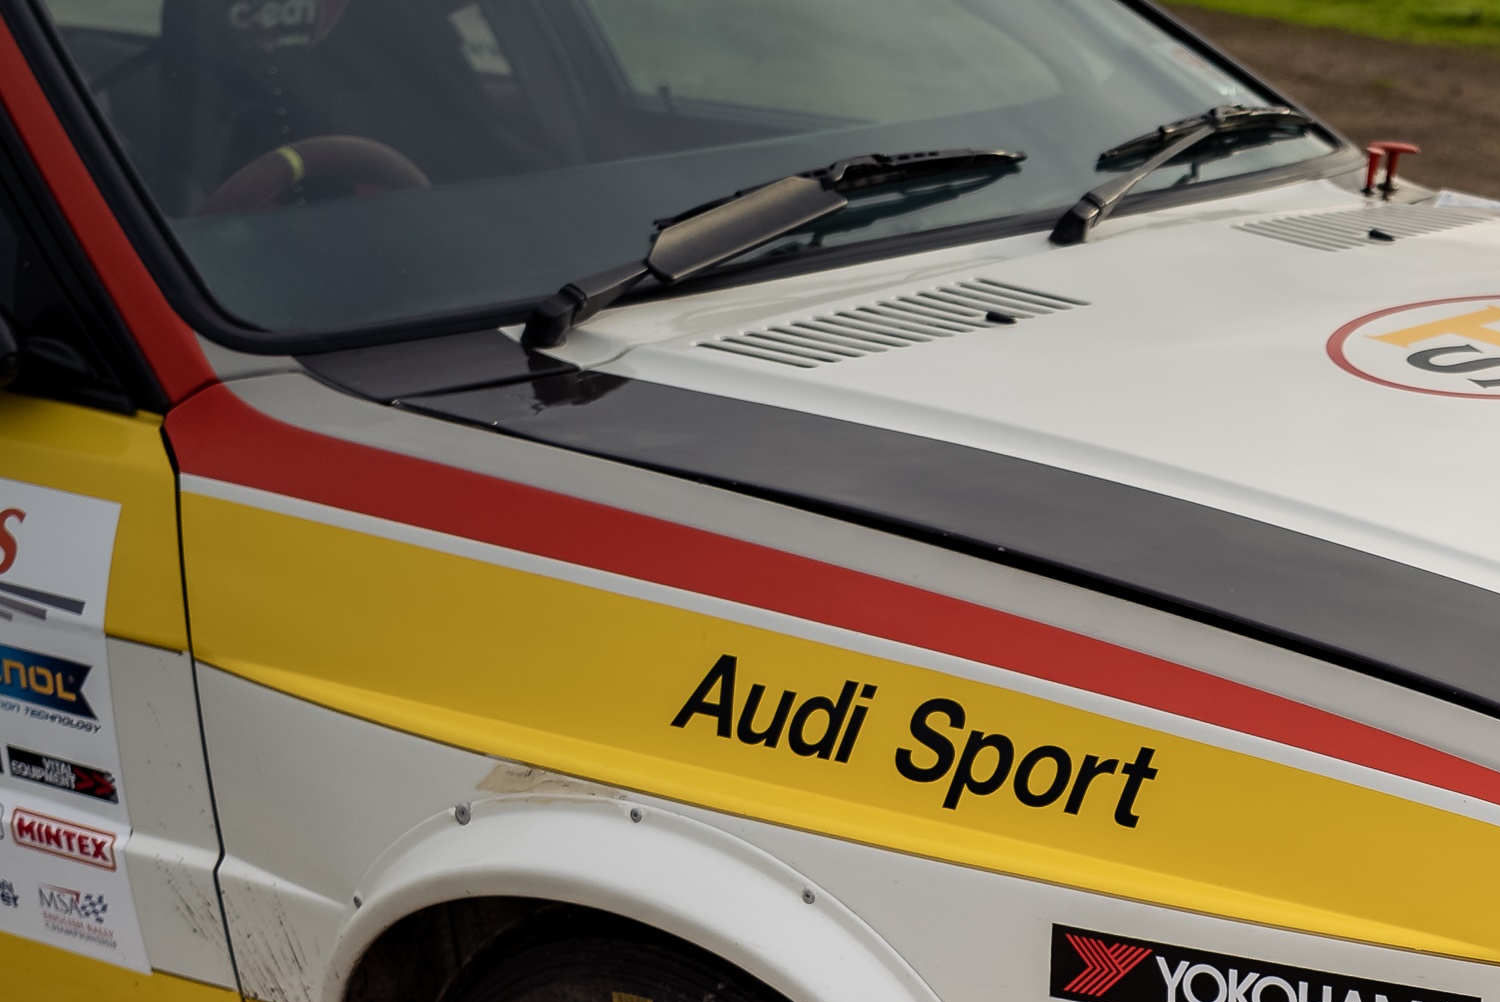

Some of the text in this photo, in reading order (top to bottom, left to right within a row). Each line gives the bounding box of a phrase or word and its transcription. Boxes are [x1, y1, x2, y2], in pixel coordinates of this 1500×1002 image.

[670, 653, 1160, 829] Audi Sport
[17, 817, 110, 861] MINTEX
[38, 886, 83, 917] MSA
